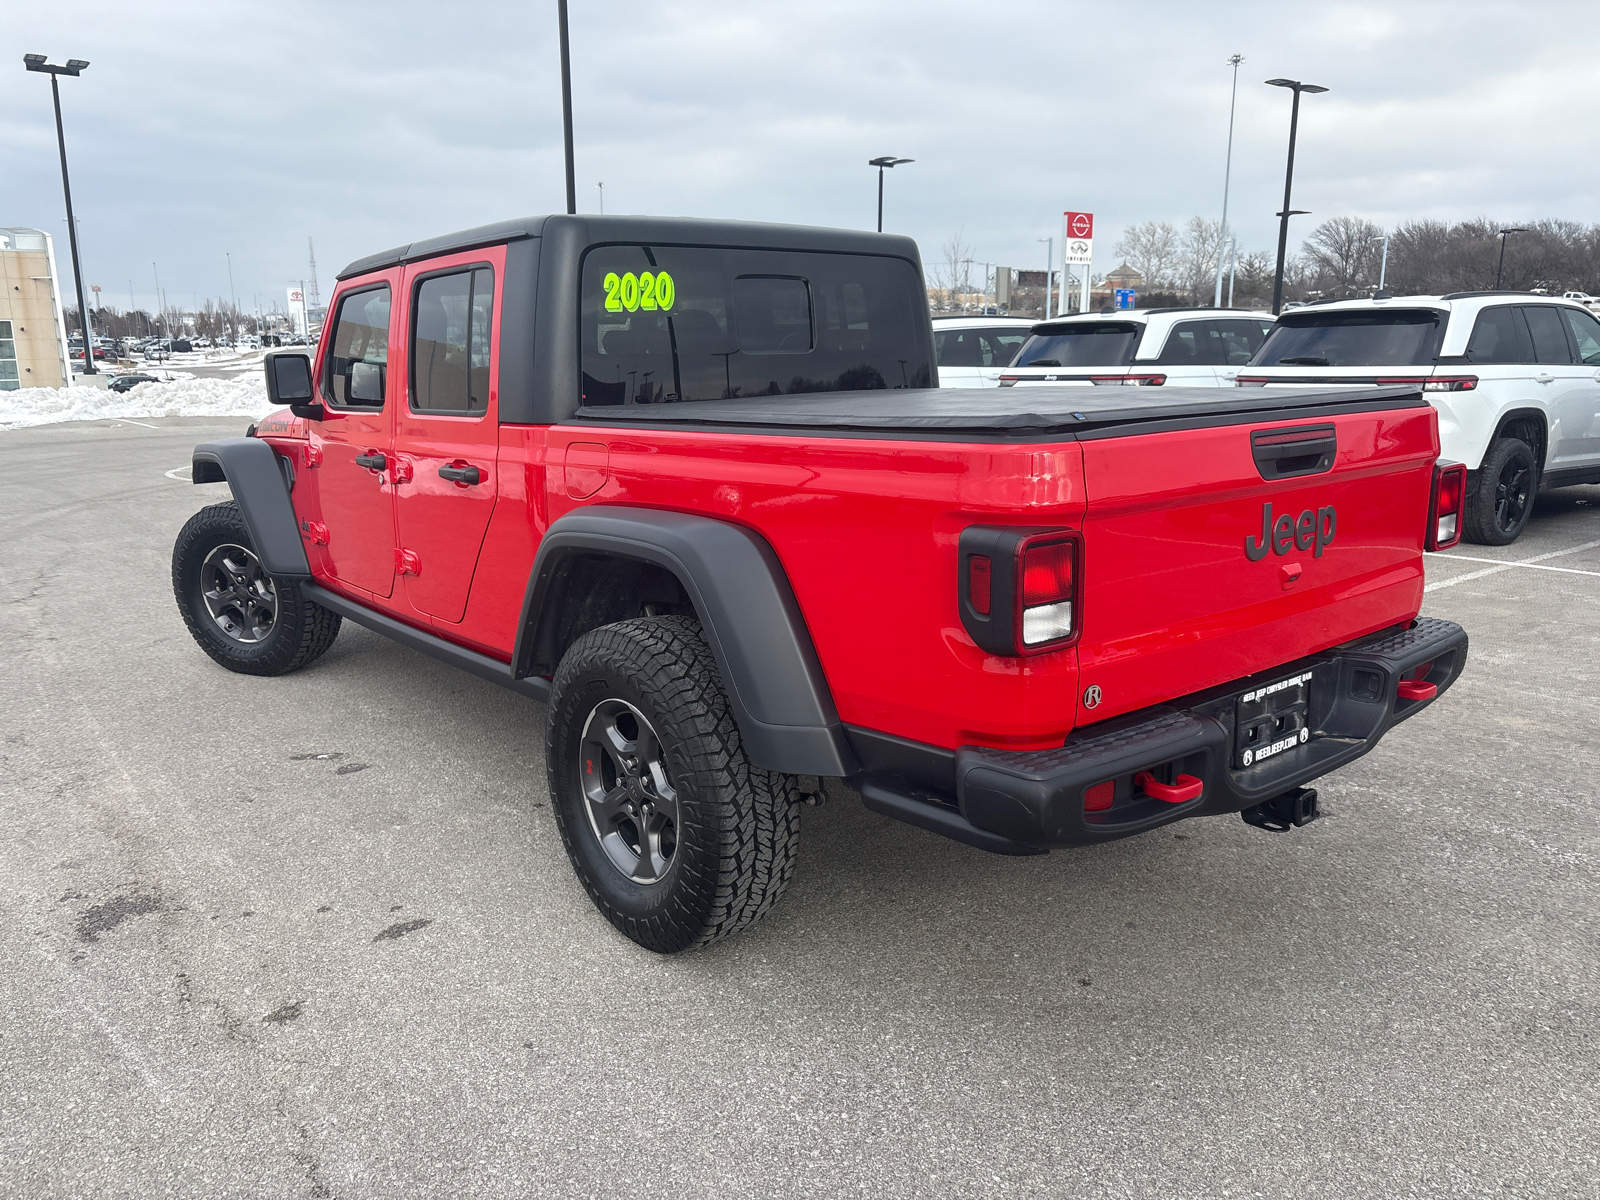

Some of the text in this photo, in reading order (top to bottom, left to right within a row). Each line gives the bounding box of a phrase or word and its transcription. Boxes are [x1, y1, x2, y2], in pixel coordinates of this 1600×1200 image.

[603, 271, 675, 312] 2020
[258, 420, 289, 432] UBICON
[301, 517, 311, 533] Jee
[1244, 502, 1337, 562] Jeep
[1243, 672, 1312, 702] REED JEEP CHRYSLER DODGE RAM
[1256, 735, 1297, 761] REEDJEEP.COM
